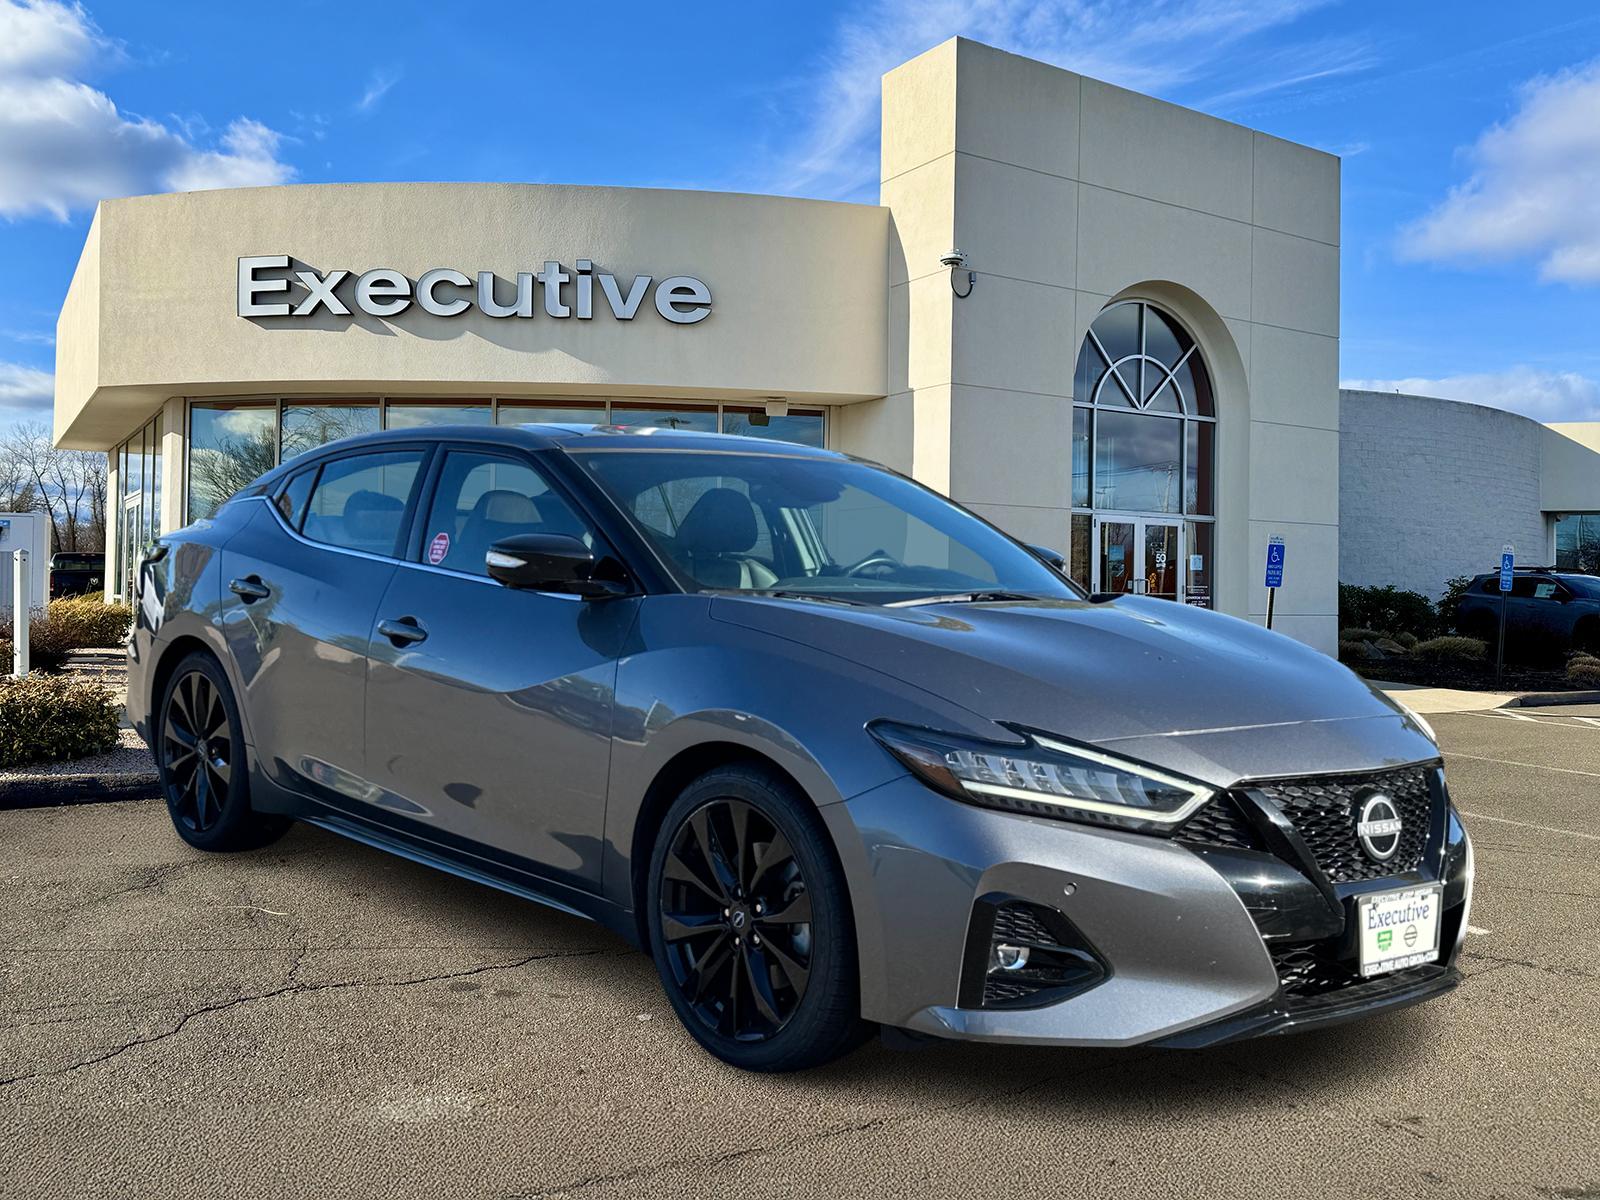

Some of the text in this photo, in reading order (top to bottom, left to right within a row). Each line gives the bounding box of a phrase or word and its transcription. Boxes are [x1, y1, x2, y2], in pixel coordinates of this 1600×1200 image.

[237, 255, 712, 324] Executive
[1360, 820, 1402, 835] NISSAN
[1368, 901, 1430, 929] Executive
